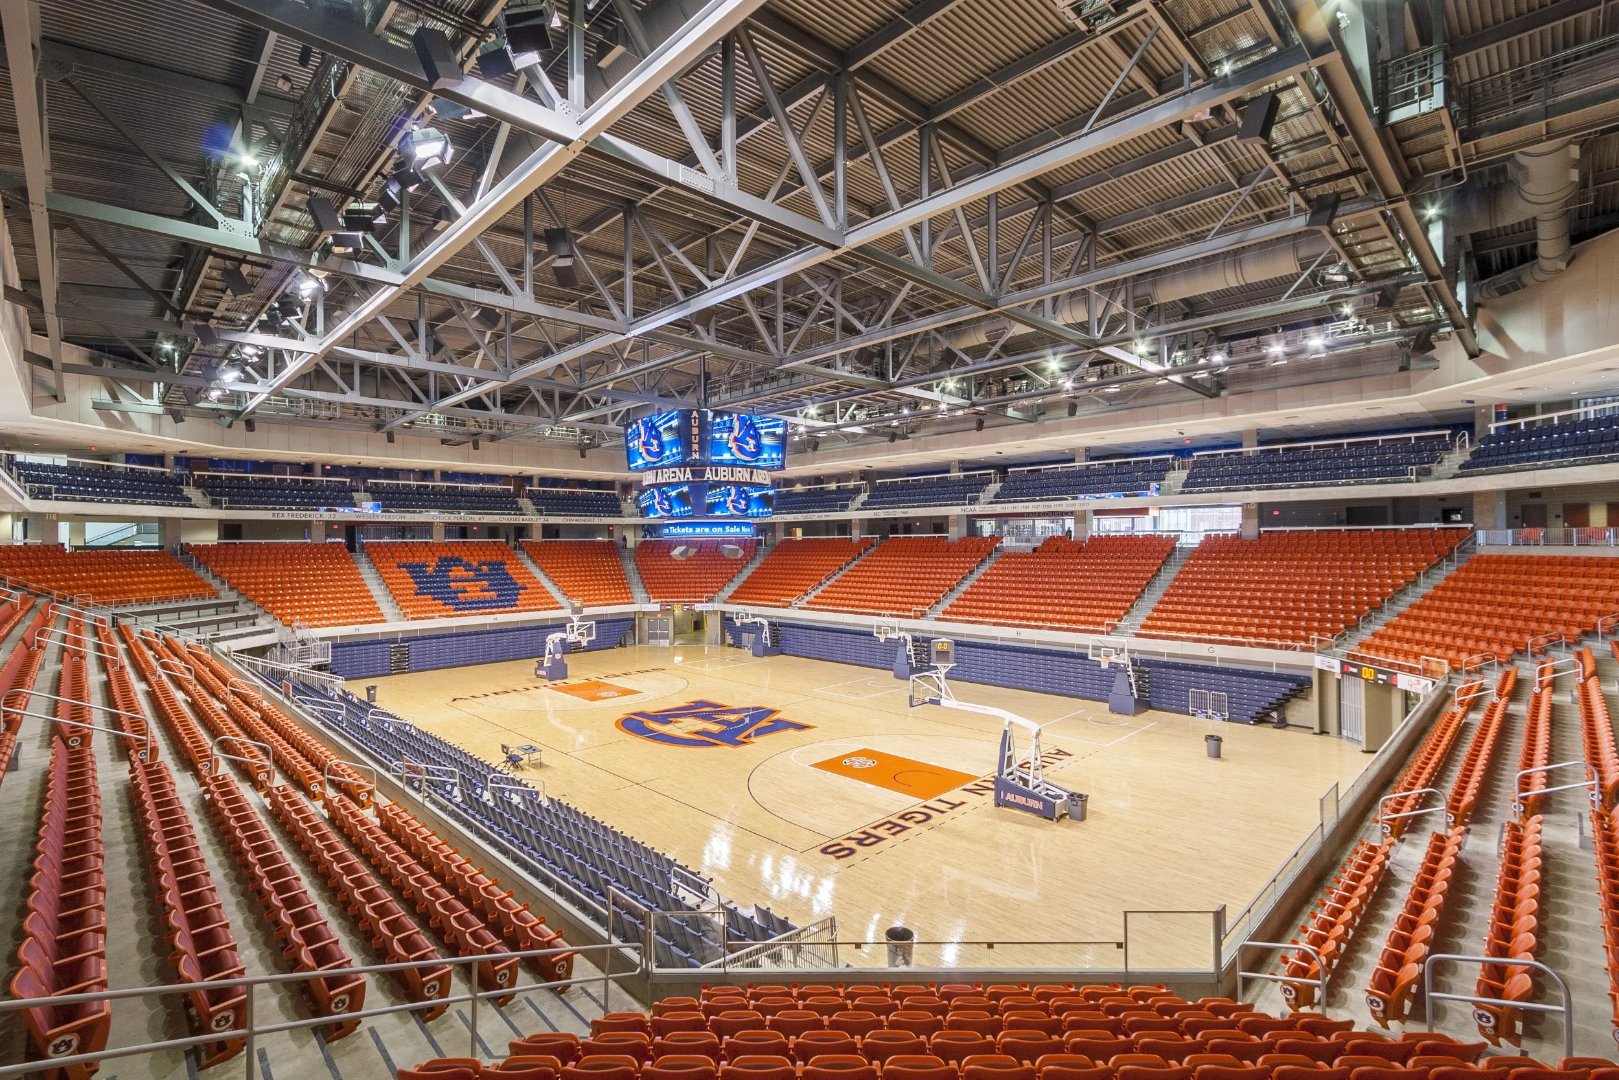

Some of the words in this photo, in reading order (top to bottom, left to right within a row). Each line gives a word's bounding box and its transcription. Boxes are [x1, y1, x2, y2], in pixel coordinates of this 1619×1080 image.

[691, 410, 700, 460] AUBURN
[657, 467, 693, 484] ARENA
[704, 466, 751, 482] AUBURN
[669, 525, 693, 533] Tickets
[725, 525, 740, 533] Sale
[1207, 646, 1215, 654] G
[451, 681, 570, 702] AUBURN
[584, 667, 667, 682] TIGERS
[1005, 792, 1043, 810] AUBURN
[819, 798, 968, 861] TIGERS
